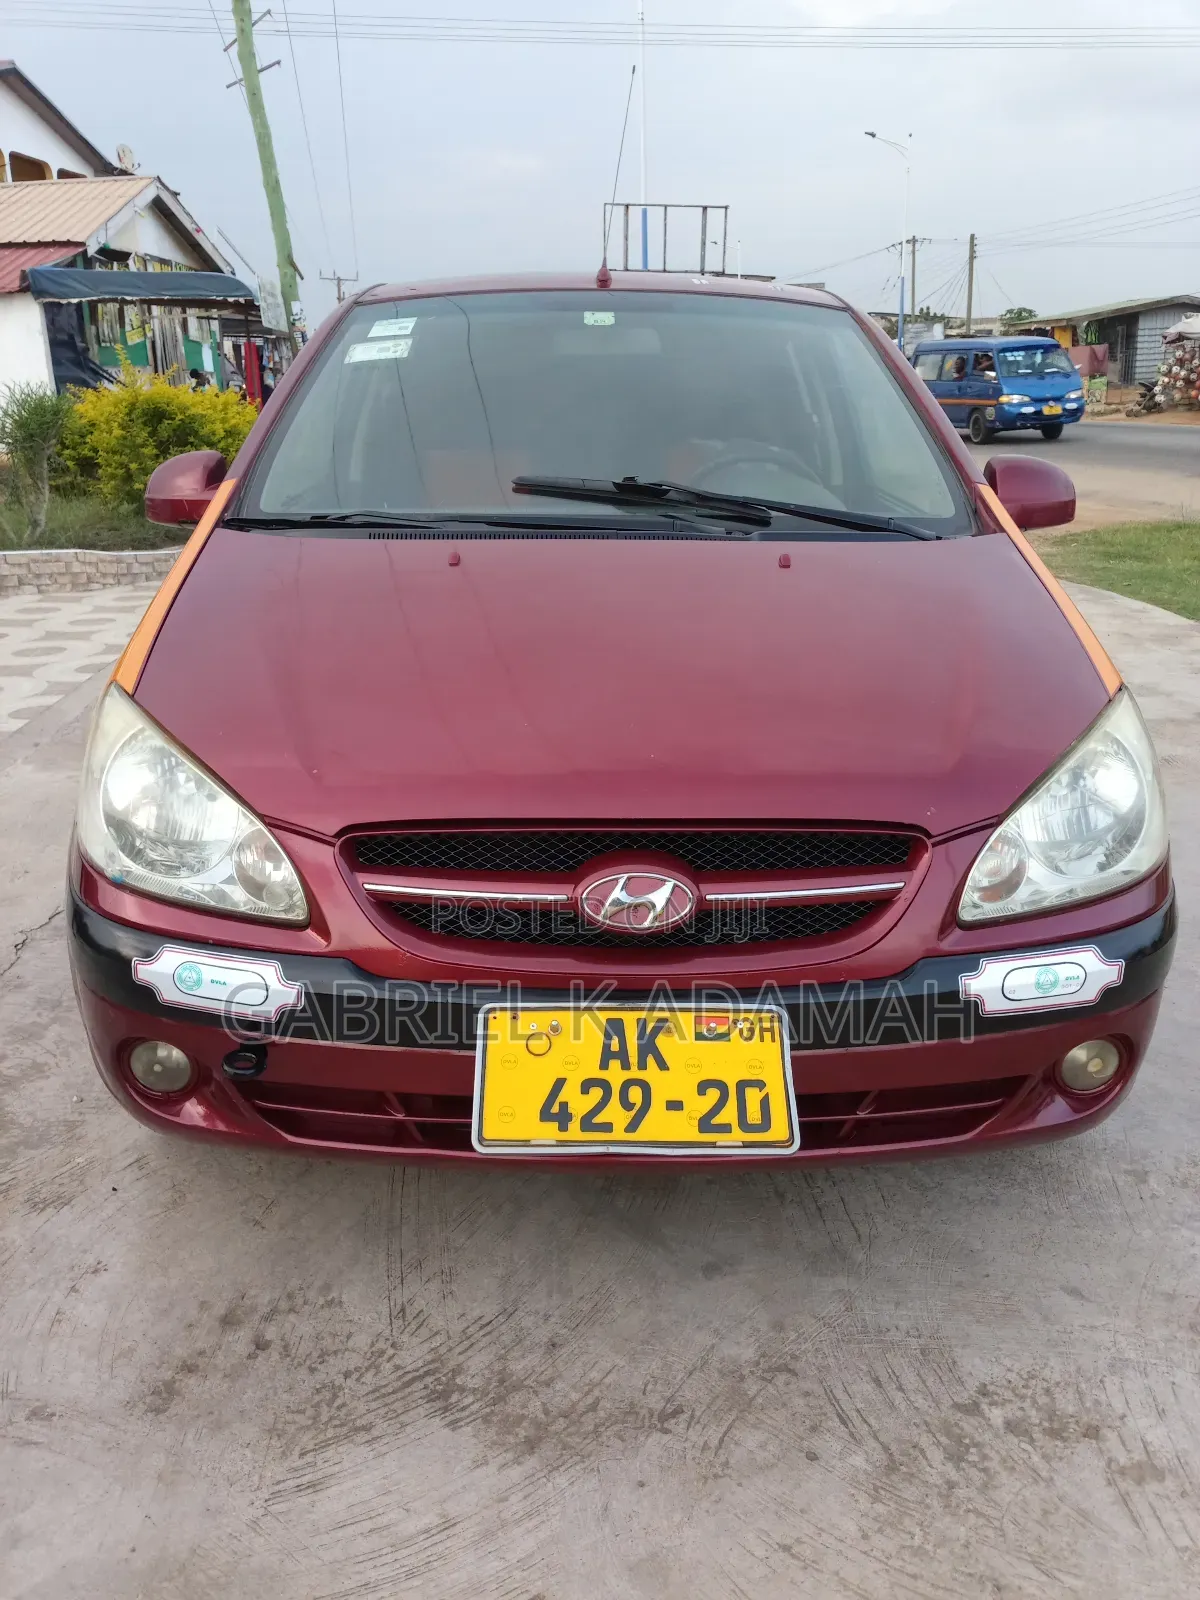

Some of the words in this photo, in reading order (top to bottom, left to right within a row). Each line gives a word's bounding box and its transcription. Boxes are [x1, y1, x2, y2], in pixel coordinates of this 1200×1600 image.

[599, 1017, 670, 1071] AK
[738, 1016, 776, 1043] GH
[539, 1077, 772, 1134] 429-20
